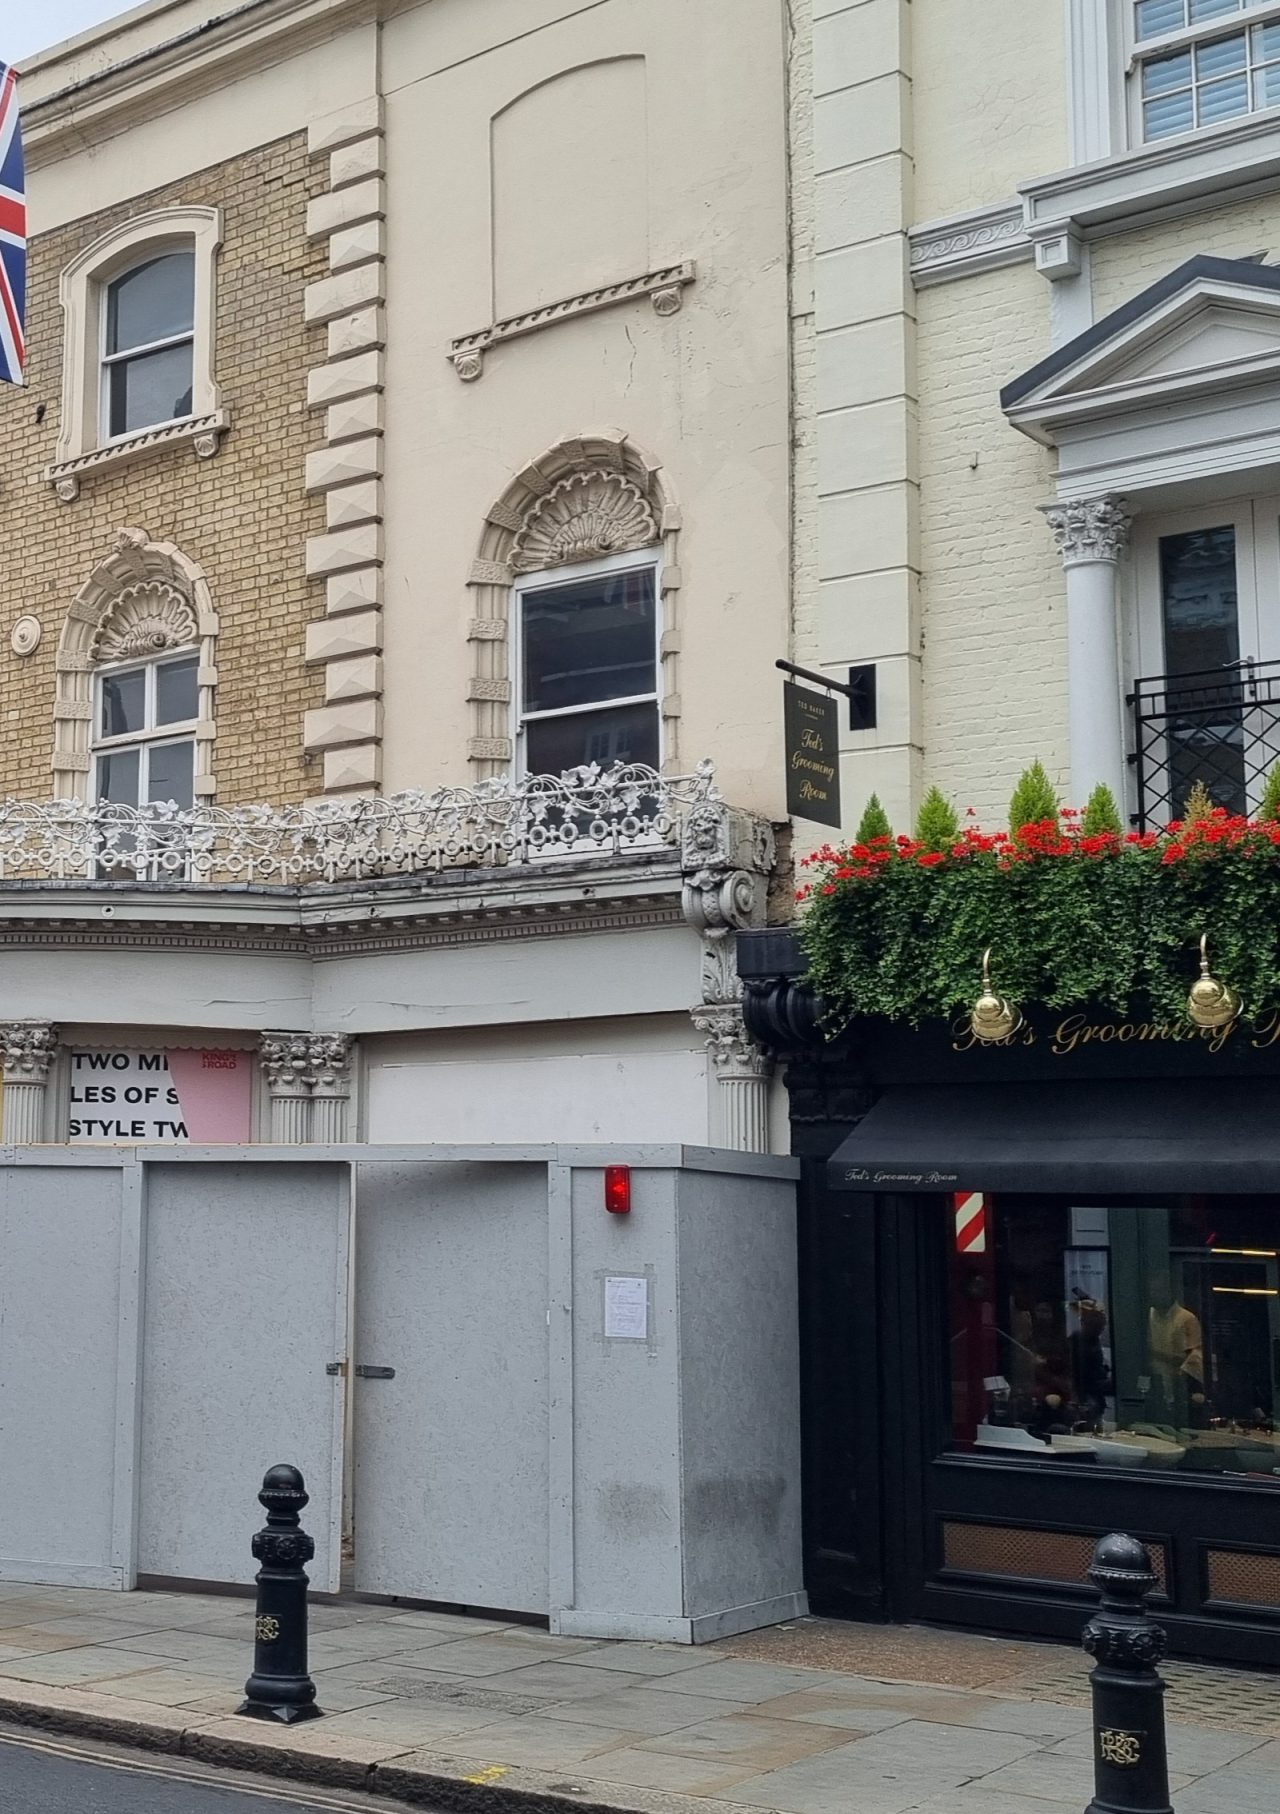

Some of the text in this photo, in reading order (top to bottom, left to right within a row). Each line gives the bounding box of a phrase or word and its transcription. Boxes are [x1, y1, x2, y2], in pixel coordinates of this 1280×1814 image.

[801, 728, 824, 752] Ted's
[791, 751, 835, 783] Grooming
[799, 779, 828, 801] Room
[71, 1052, 130, 1071] TWO
[71, 1086, 117, 1103] LES
[124, 1086, 160, 1104] OF
[69, 1119, 146, 1137] STYLE
[844, 1168, 958, 1185] Ted's Grooming Room
